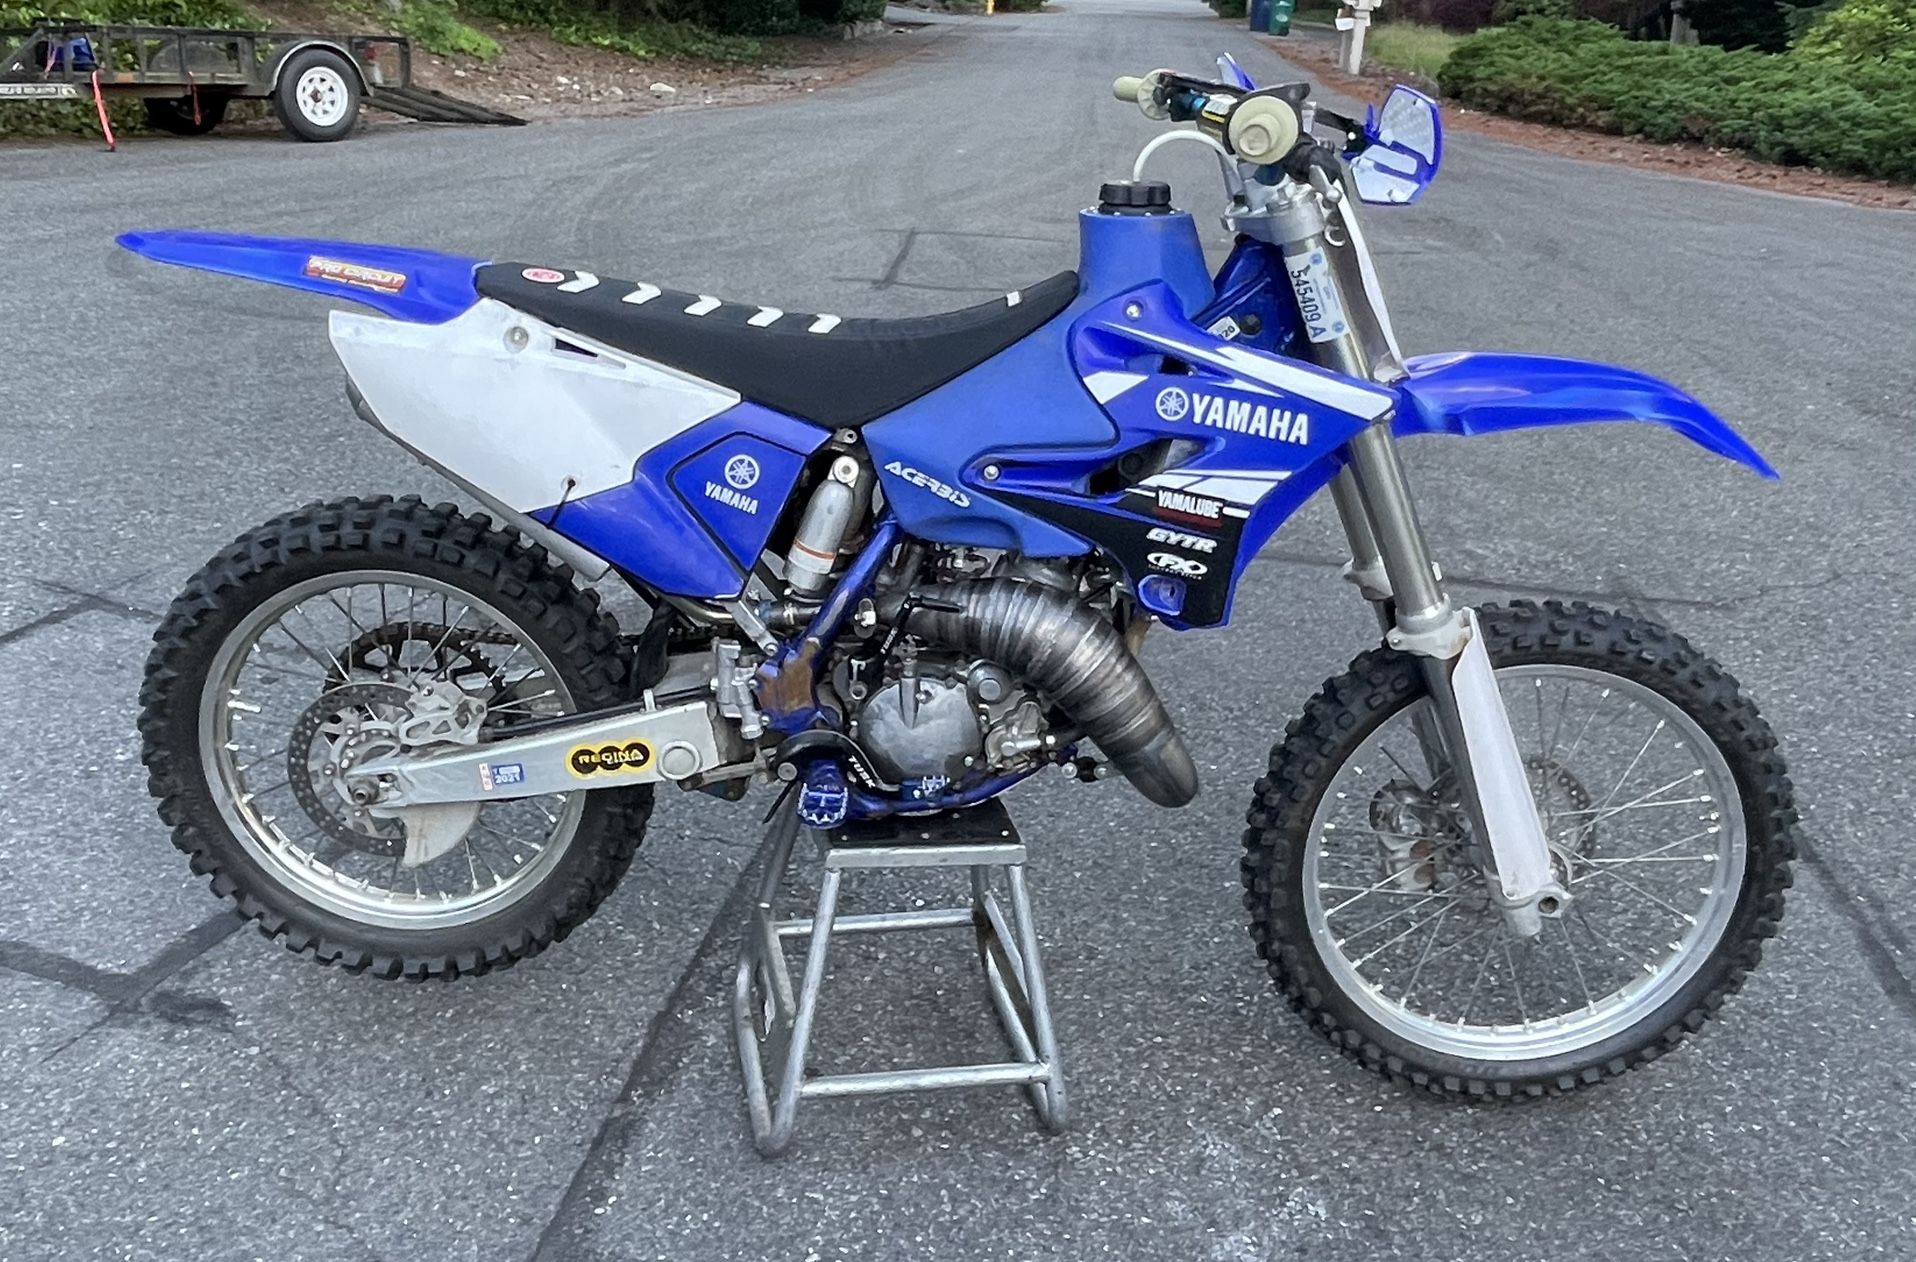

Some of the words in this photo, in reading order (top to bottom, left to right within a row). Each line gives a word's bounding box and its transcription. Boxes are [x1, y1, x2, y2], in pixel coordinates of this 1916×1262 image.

[1190, 392, 1310, 446] YAMAHA
[704, 480, 759, 515] YAMAHA
[884, 461, 971, 508] ACERBIS
[1157, 489, 1224, 519] YAMALUBE
[1145, 526, 1218, 553] GYTR
[577, 748, 645, 766] REGINA
[848, 754, 877, 789] TUSK
[494, 772, 521, 785] 2021
